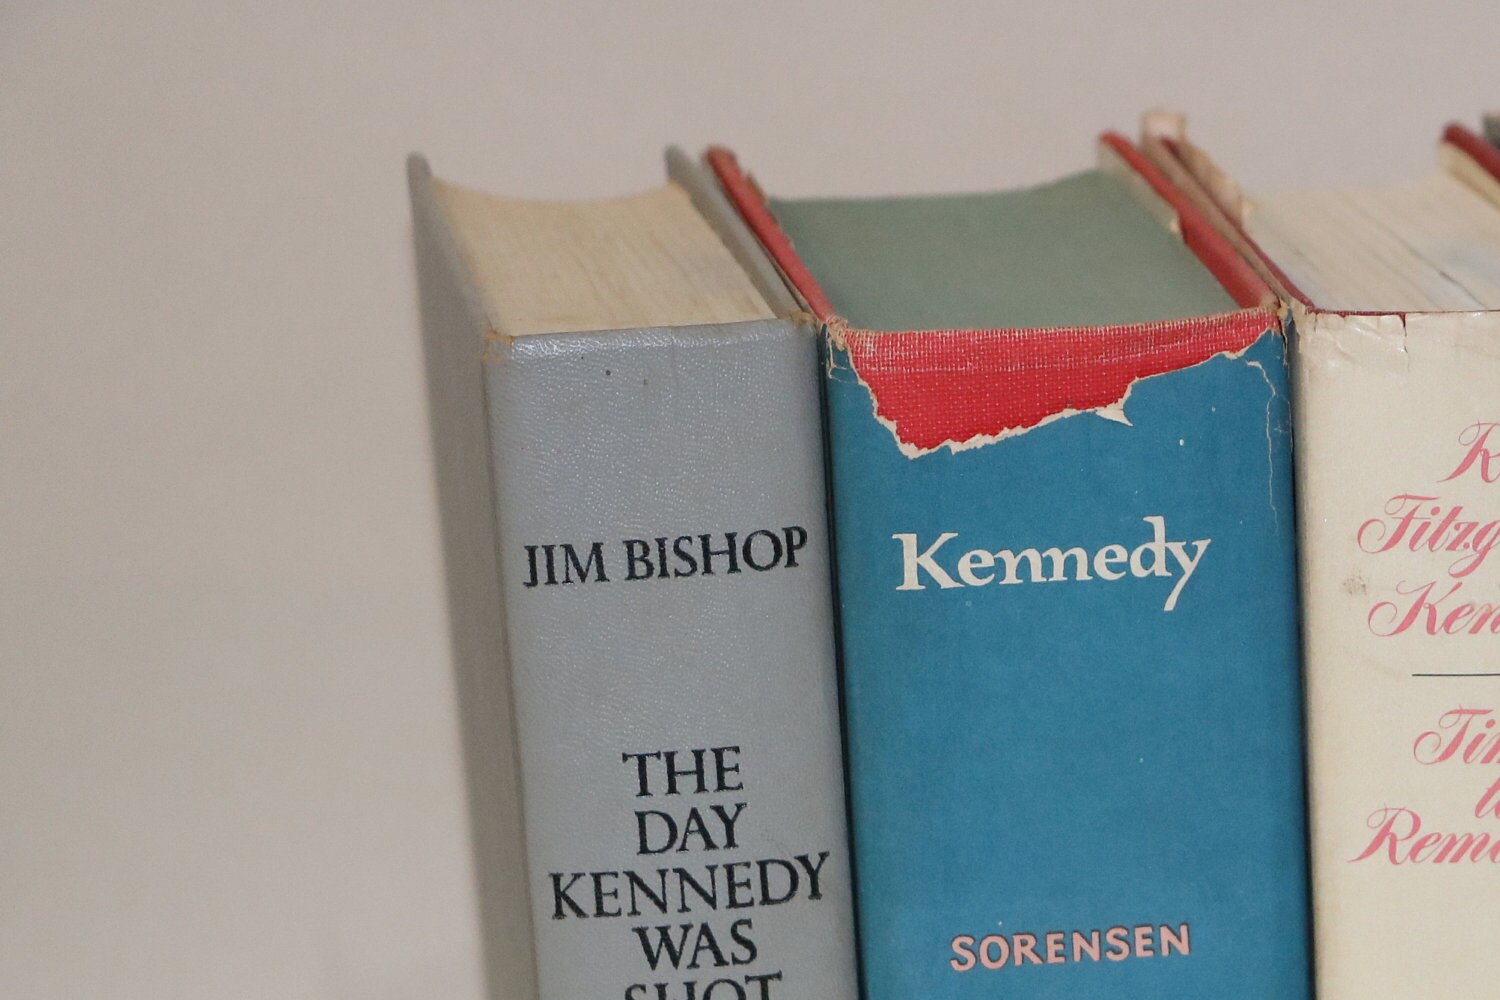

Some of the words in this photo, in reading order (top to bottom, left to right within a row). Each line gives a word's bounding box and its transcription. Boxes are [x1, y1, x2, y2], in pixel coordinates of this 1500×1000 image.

[522, 540, 610, 589] JIM
[622, 525, 808, 582] BISHOP
[892, 514, 1212, 612] Kennedy
[622, 745, 745, 797] THE
[633, 801, 748, 856] DAY
[548, 851, 831, 920] KENNEDY
[632, 917, 758, 971] WAS
[949, 922, 1192, 973] SORENSEN
